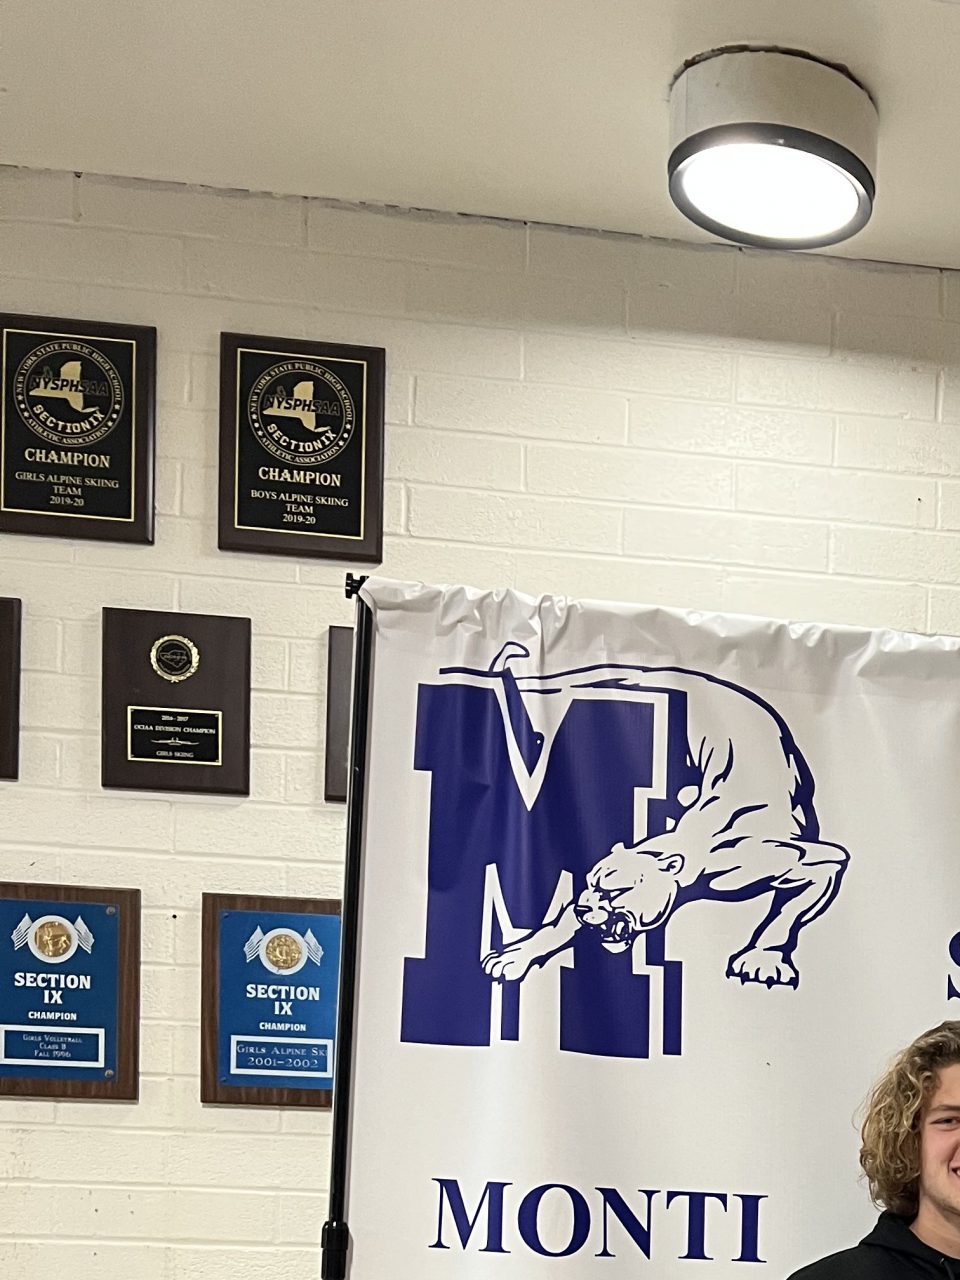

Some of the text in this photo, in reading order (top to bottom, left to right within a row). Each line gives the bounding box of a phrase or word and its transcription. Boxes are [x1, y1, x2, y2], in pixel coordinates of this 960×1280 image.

[37, 343, 60, 356] STATE
[61, 343, 91, 354] PUBLIC
[92, 352, 111, 370] HIGH
[109, 369, 121, 400] SCHOOL
[271, 363, 293, 377] STATE
[294, 363, 324, 376] PUBLIC
[324, 372, 342, 390] HIGH
[340, 389, 353, 422] SCHOOL
[28, 418, 109, 444] ATHLETIC ASSOCIATION
[24, 448, 111, 468] CHAMPION
[261, 437, 340, 464] ATHLETIC ASSOCIATION
[15, 471, 119, 489] GIRLS ALPINE SKIING
[258, 466, 341, 487] CHAMPION
[52, 485, 82, 496] TEAM
[250, 489, 349, 507] BOYS ALPINE SKIING
[49, 496, 85, 507] 2019-20
[285, 503, 314, 514] TEAM
[282, 513, 317, 525] 2019-20
[183, 726, 216, 734] CHAMPION
[14, 972, 91, 989] SECTION
[43, 990, 63, 1004] IX
[246, 984, 320, 1001] SECTION
[28, 1011, 77, 1020] CHAMPION
[274, 1001, 293, 1016] IX
[259, 1022, 306, 1031] CHAMPION
[247, 1057, 319, 1068] 2001-2002
[428, 1178, 769, 1263] MONTI
